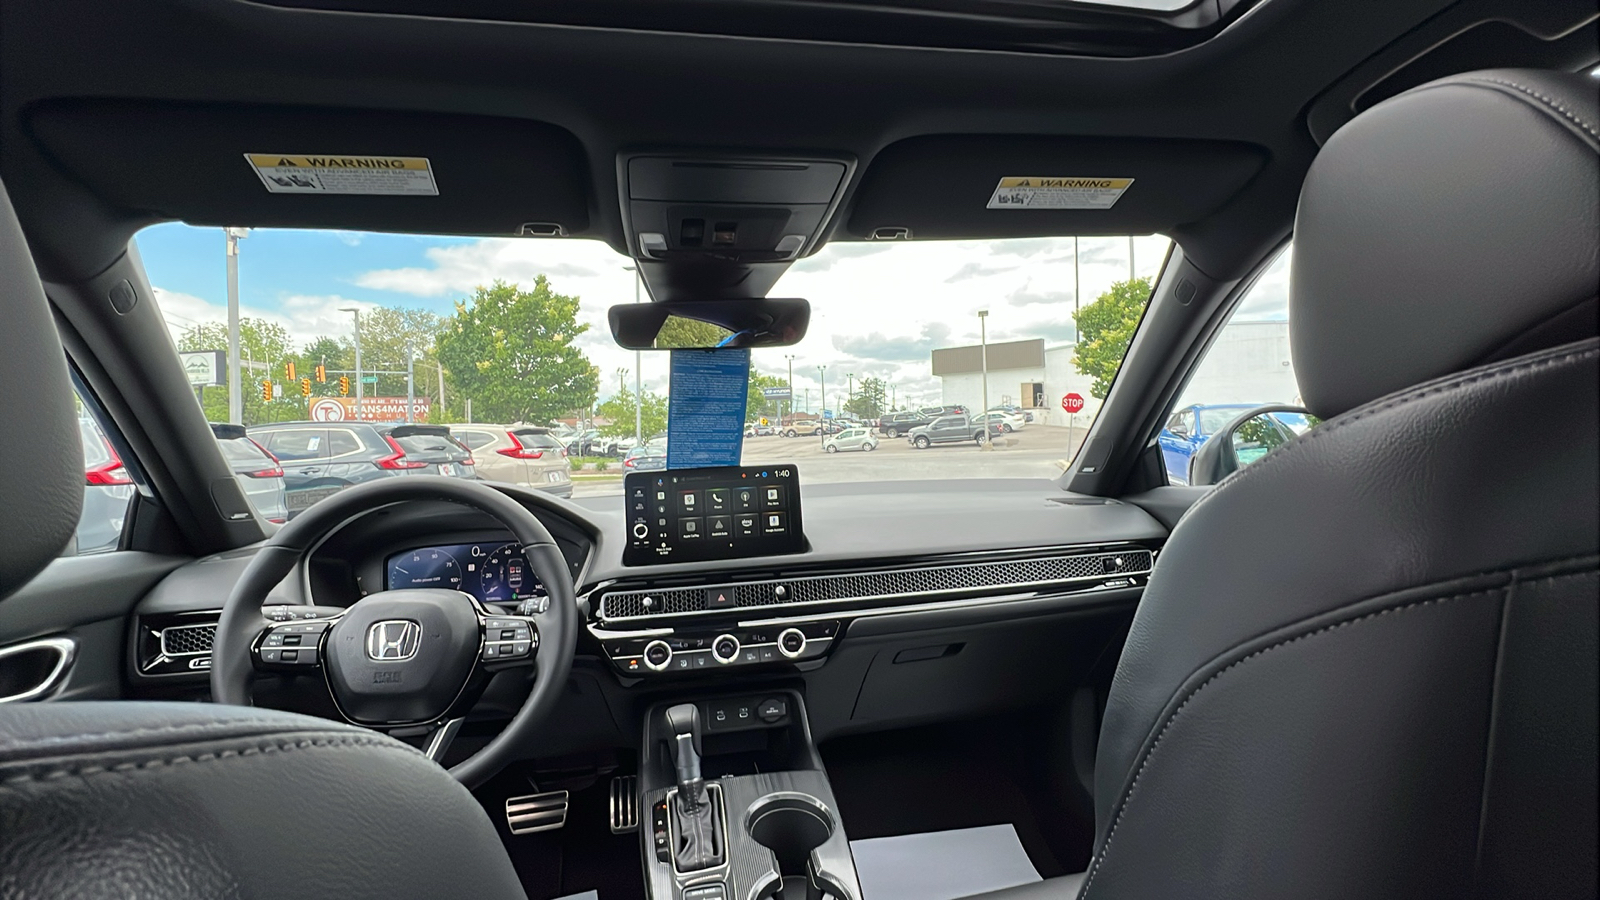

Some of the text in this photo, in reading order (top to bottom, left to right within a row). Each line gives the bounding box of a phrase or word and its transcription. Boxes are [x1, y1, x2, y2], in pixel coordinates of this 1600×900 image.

[305, 157, 405, 169] WARNING
[1040, 180, 1112, 188] WARNING
[1063, 398, 1083, 408] STOP
[347, 405, 429, 413] TRANS4MATON
[774, 470, 790, 478] 1:40
[471, 545, 480, 557] 0
